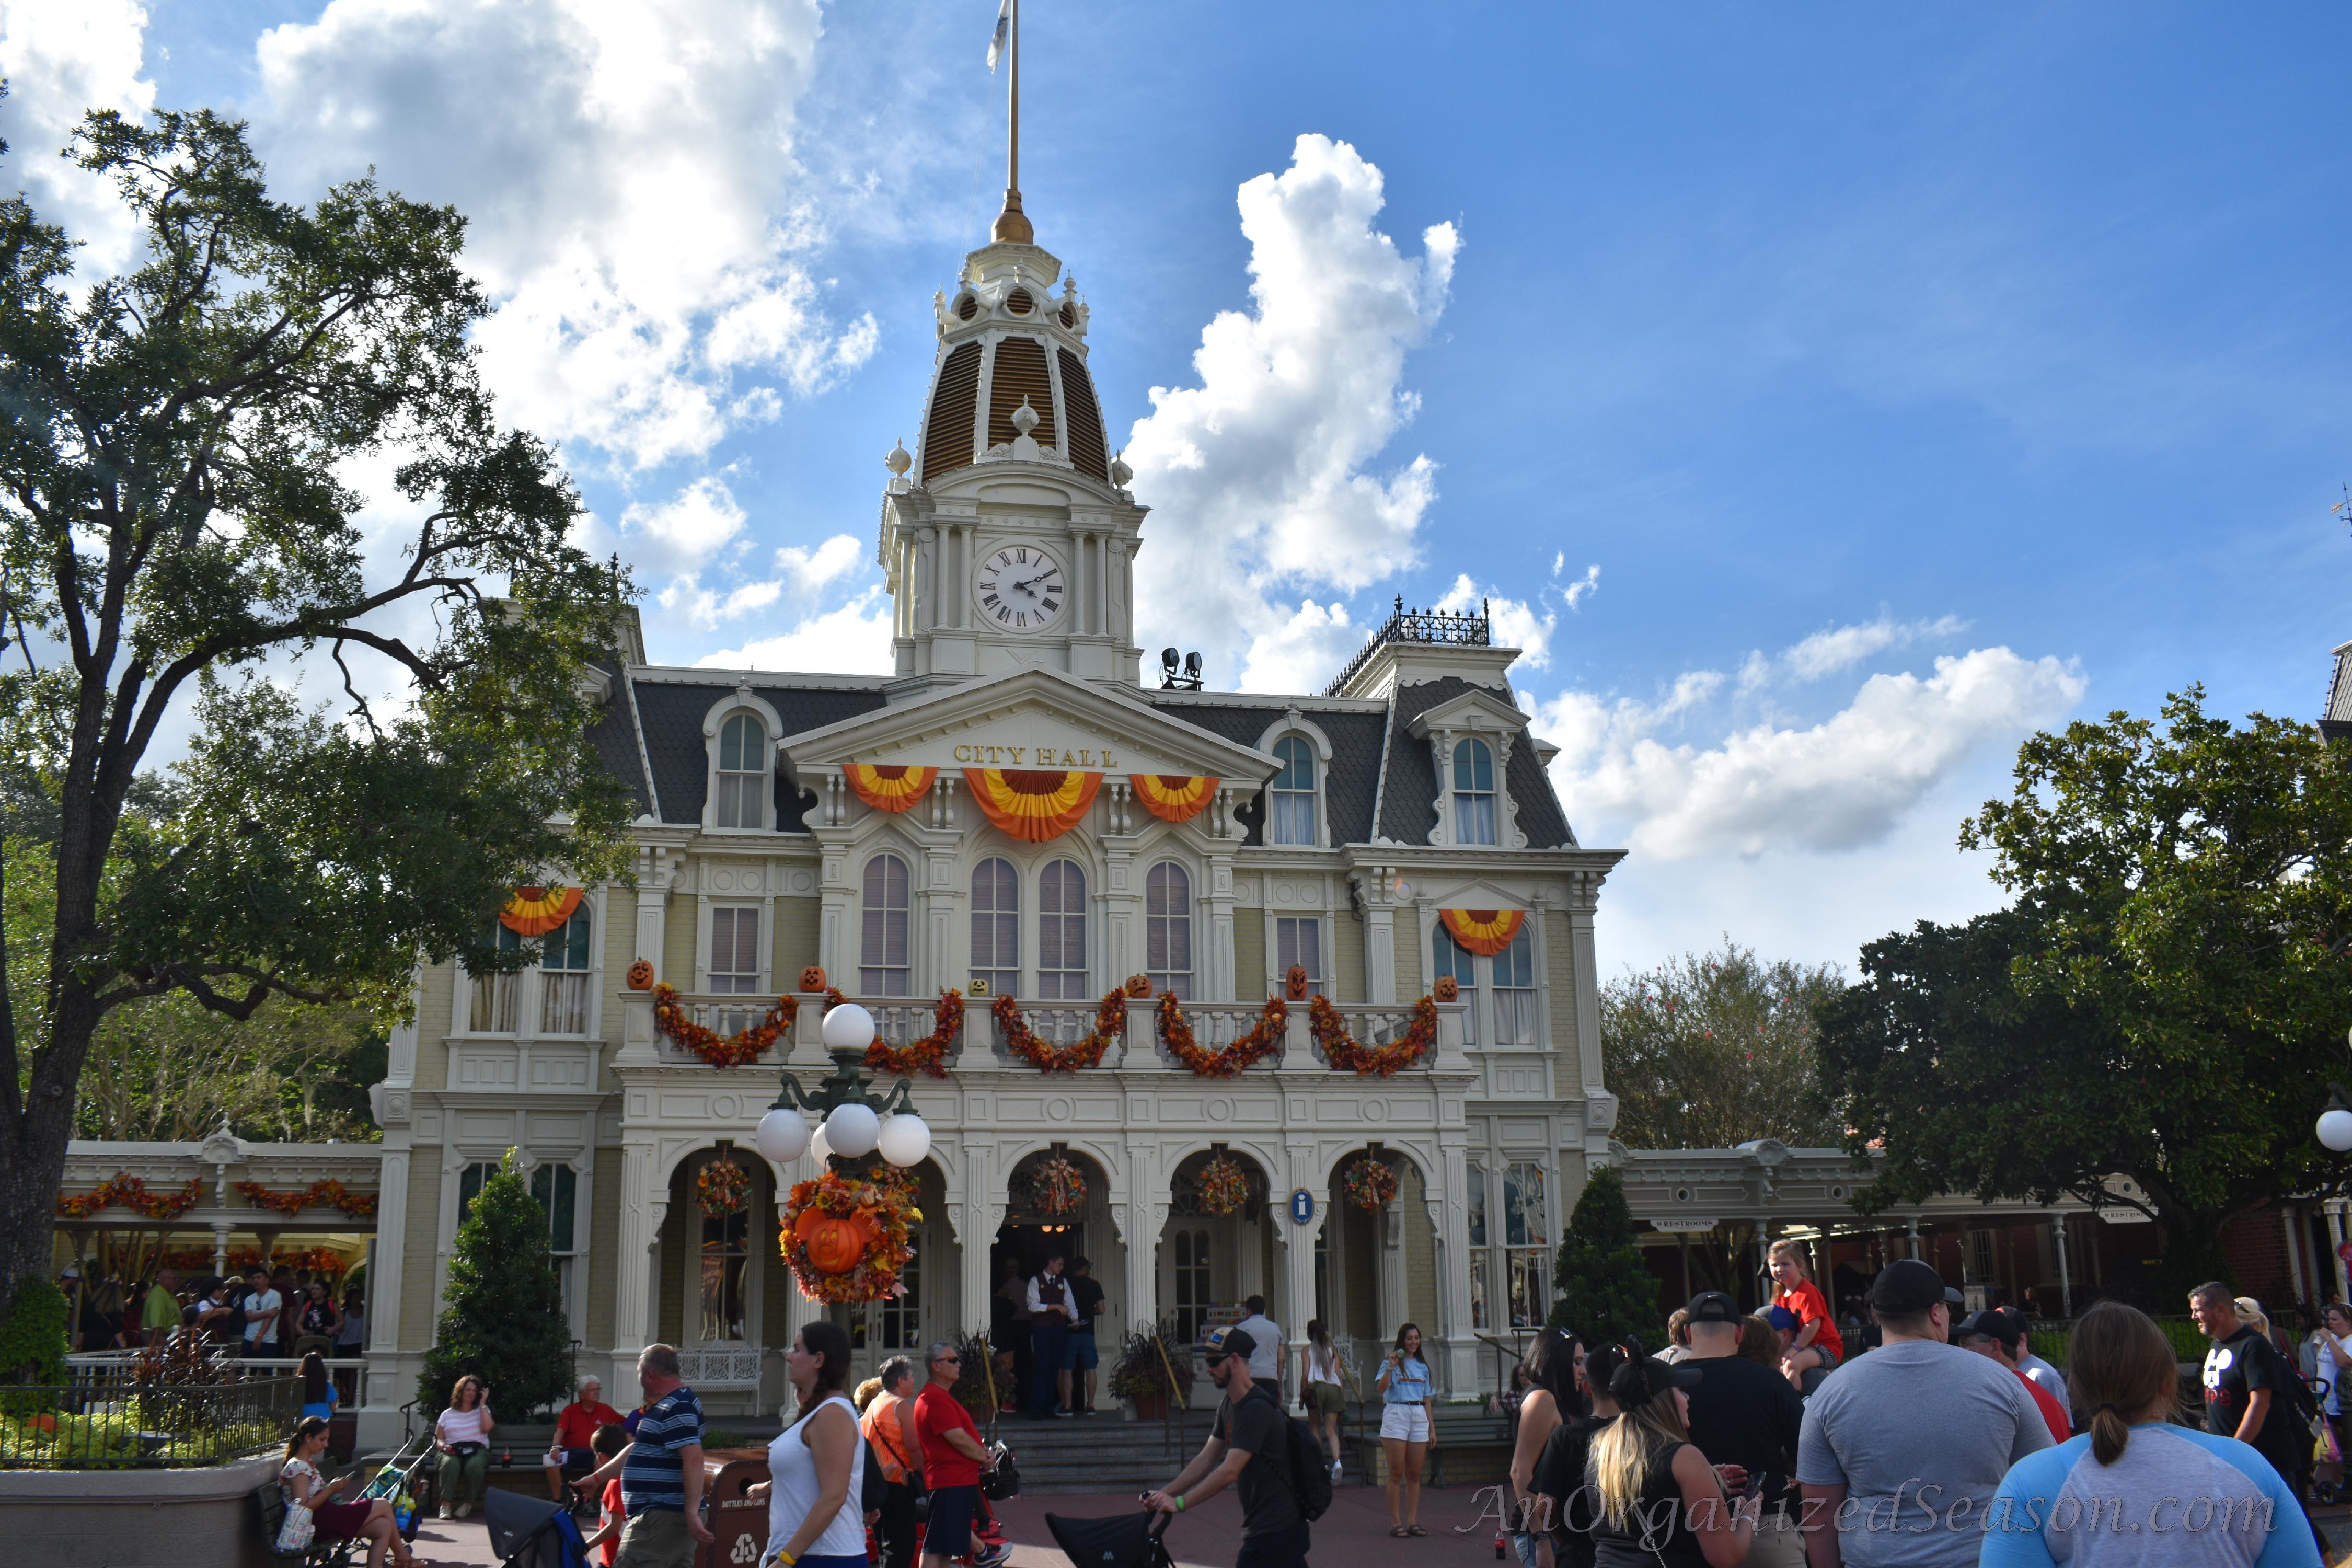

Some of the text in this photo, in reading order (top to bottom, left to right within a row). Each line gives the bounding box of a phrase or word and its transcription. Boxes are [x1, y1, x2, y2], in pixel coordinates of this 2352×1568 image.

[998, 551, 1011, 567] XI
[1016, 548, 1027, 563] XII
[1033, 554, 1043, 567] I
[985, 564, 1000, 576] X
[980, 582, 996, 590] IX
[983, 593, 1001, 611] VIII
[997, 606, 1011, 623] VII
[1016, 612, 1027, 627] VI
[1034, 609, 1045, 624] V
[954, 744, 1118, 768] CITY HALL
[722, 1499, 743, 1508] BOTTLES
